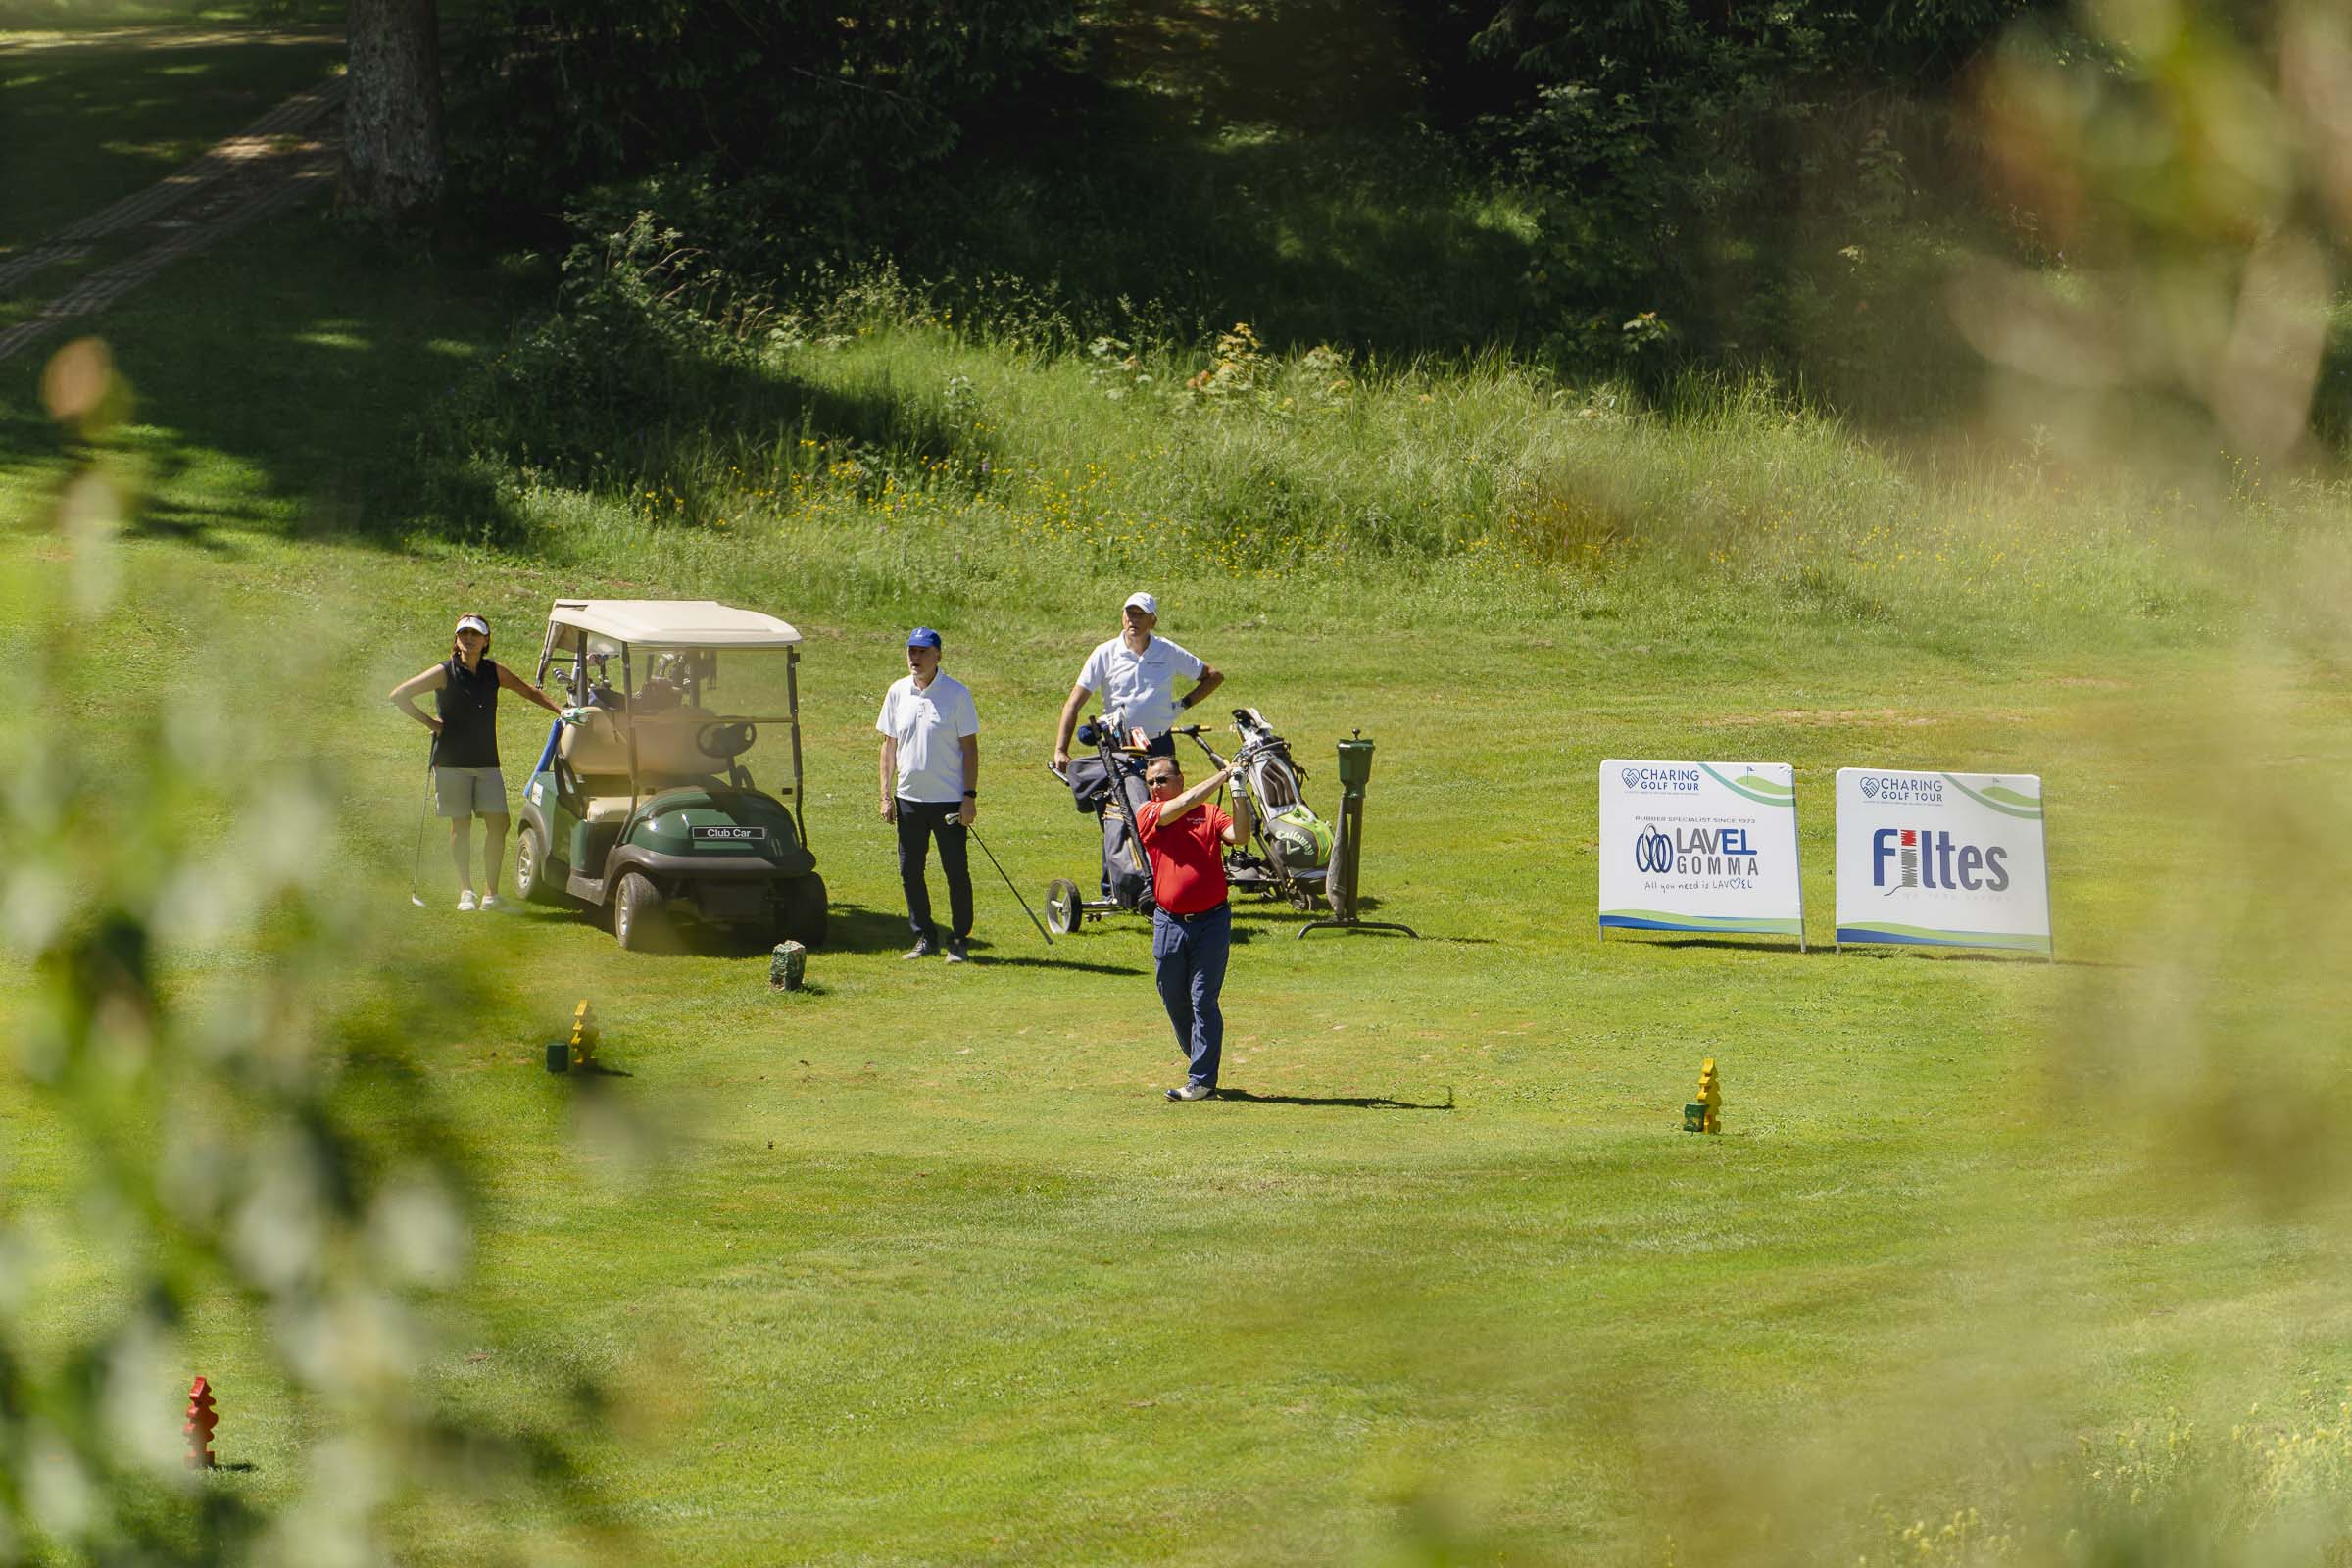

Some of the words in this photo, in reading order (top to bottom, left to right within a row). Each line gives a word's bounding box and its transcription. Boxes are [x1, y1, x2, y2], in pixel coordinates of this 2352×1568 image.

[1641, 768, 1699, 781] CHARING
[1881, 777, 1943, 791] CHARING
[1881, 791, 1910, 800] GOLF
[1915, 792, 1943, 801] TOUR
[1677, 828, 1758, 855] LAVEL
[1677, 856, 1759, 876] GOMMA
[1873, 828, 2009, 892] Filtes
[1645, 880, 1657, 890] All
[1678, 881, 1699, 890] need
[1702, 881, 1709, 890] is
